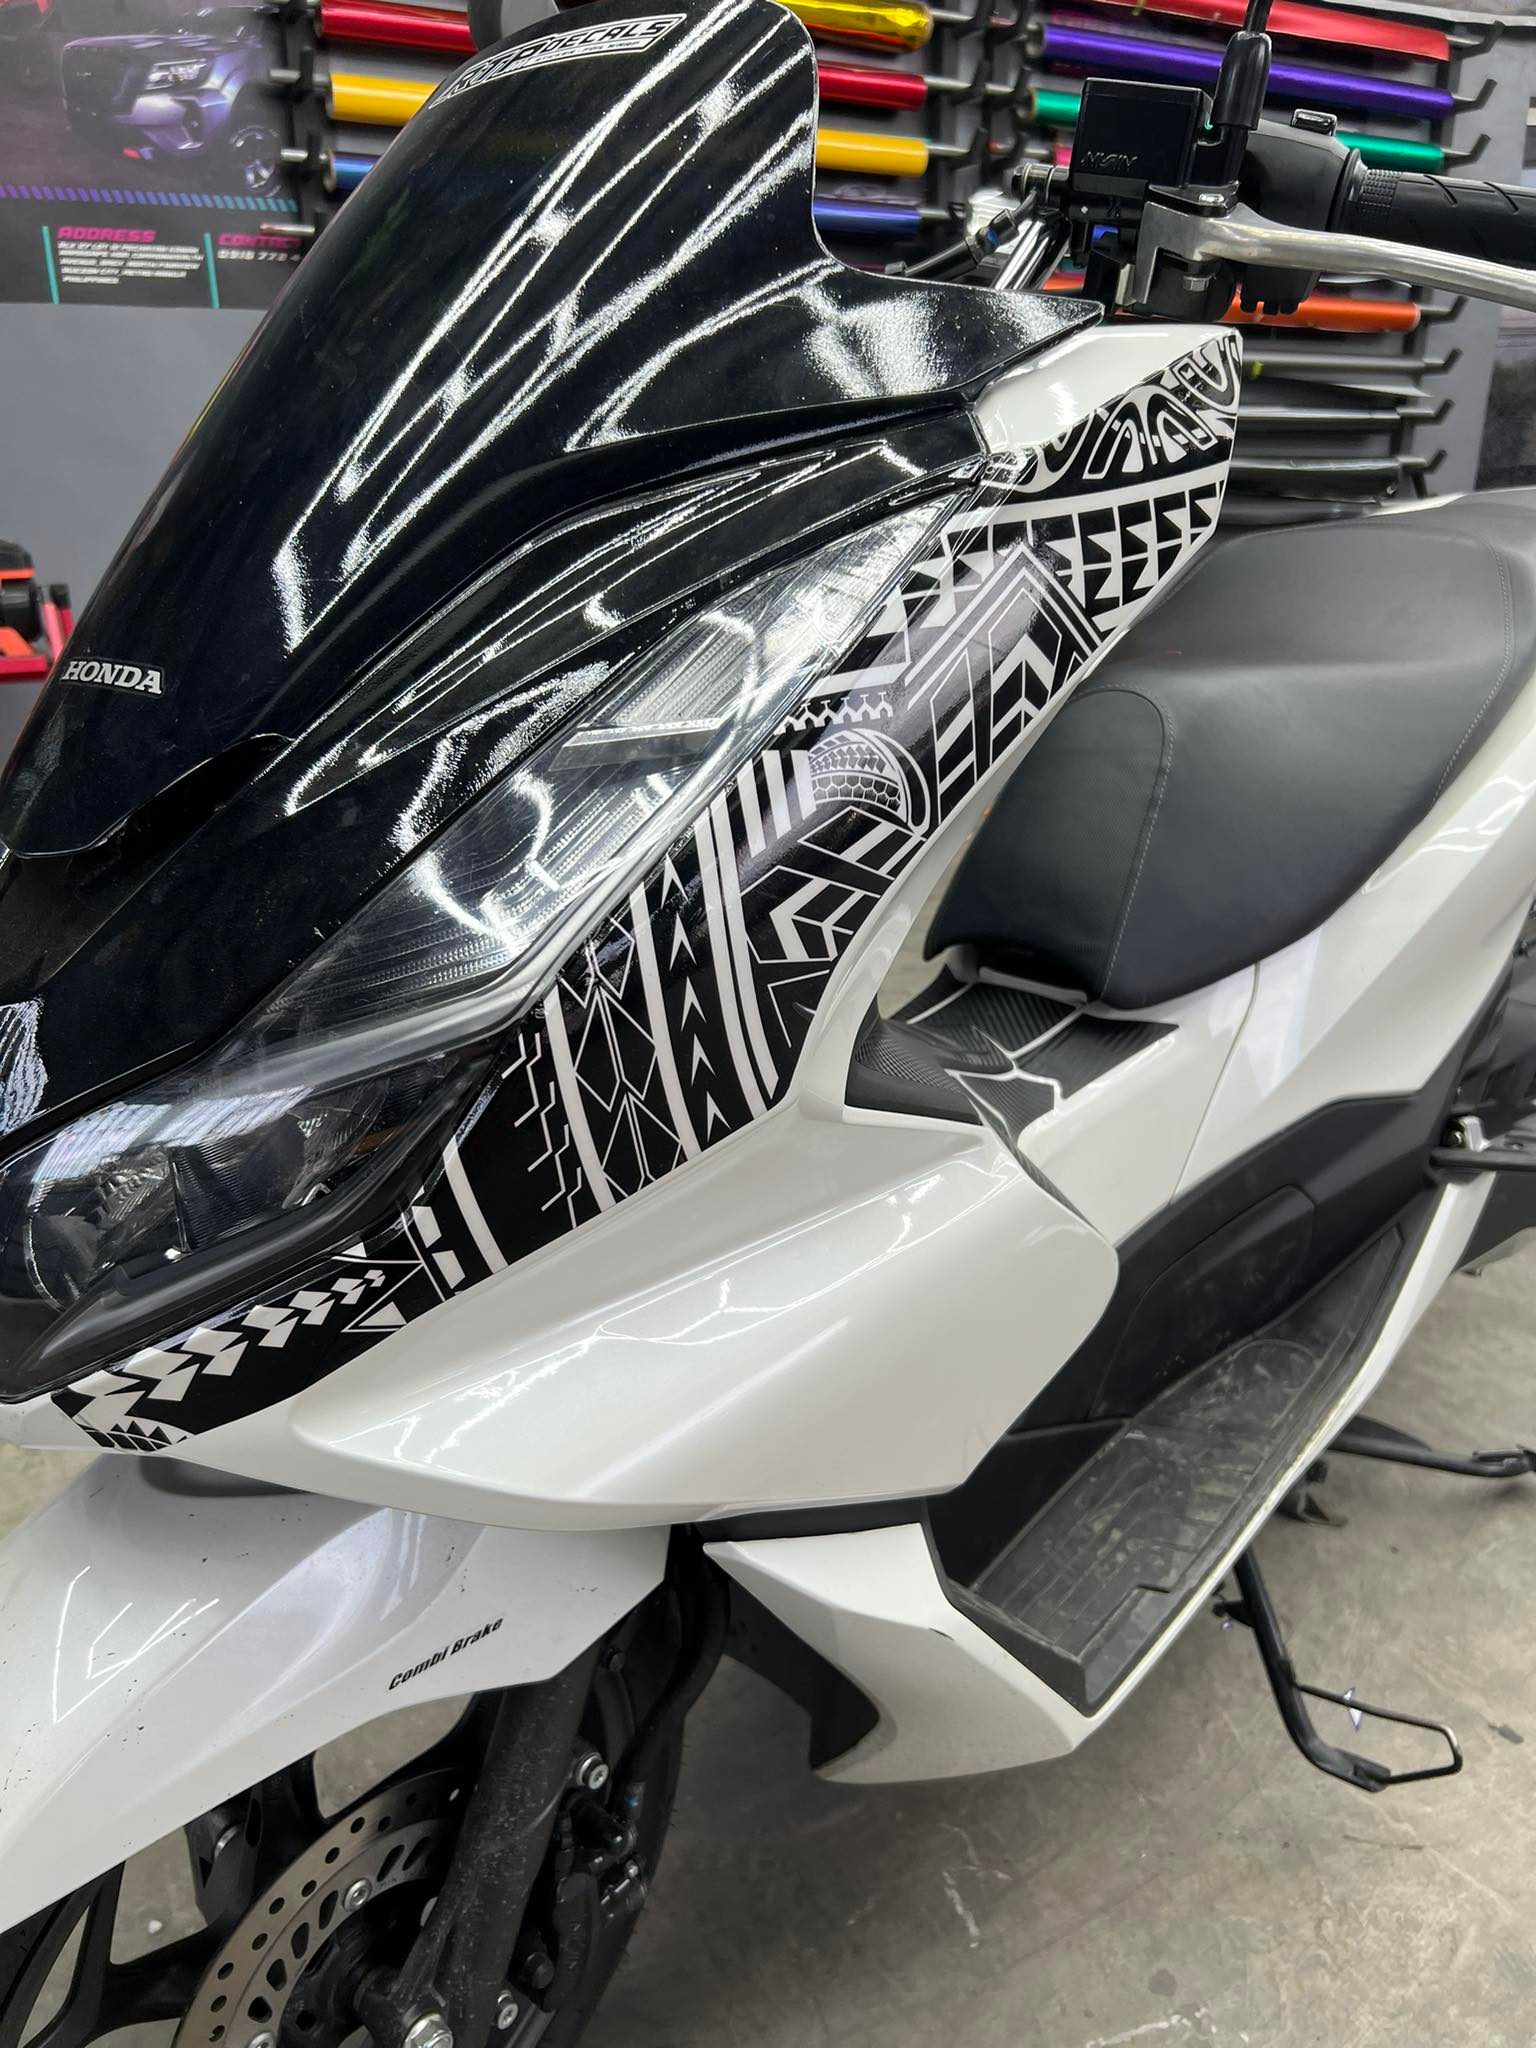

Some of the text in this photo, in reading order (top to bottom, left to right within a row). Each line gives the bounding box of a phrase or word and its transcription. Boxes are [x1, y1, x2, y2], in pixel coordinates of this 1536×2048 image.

[540, 20, 675, 53] DECALS
[57, 226, 157, 243] ADDRESS
[61, 660, 162, 695] HONDA
[388, 1617, 504, 1691] Combi Brake
